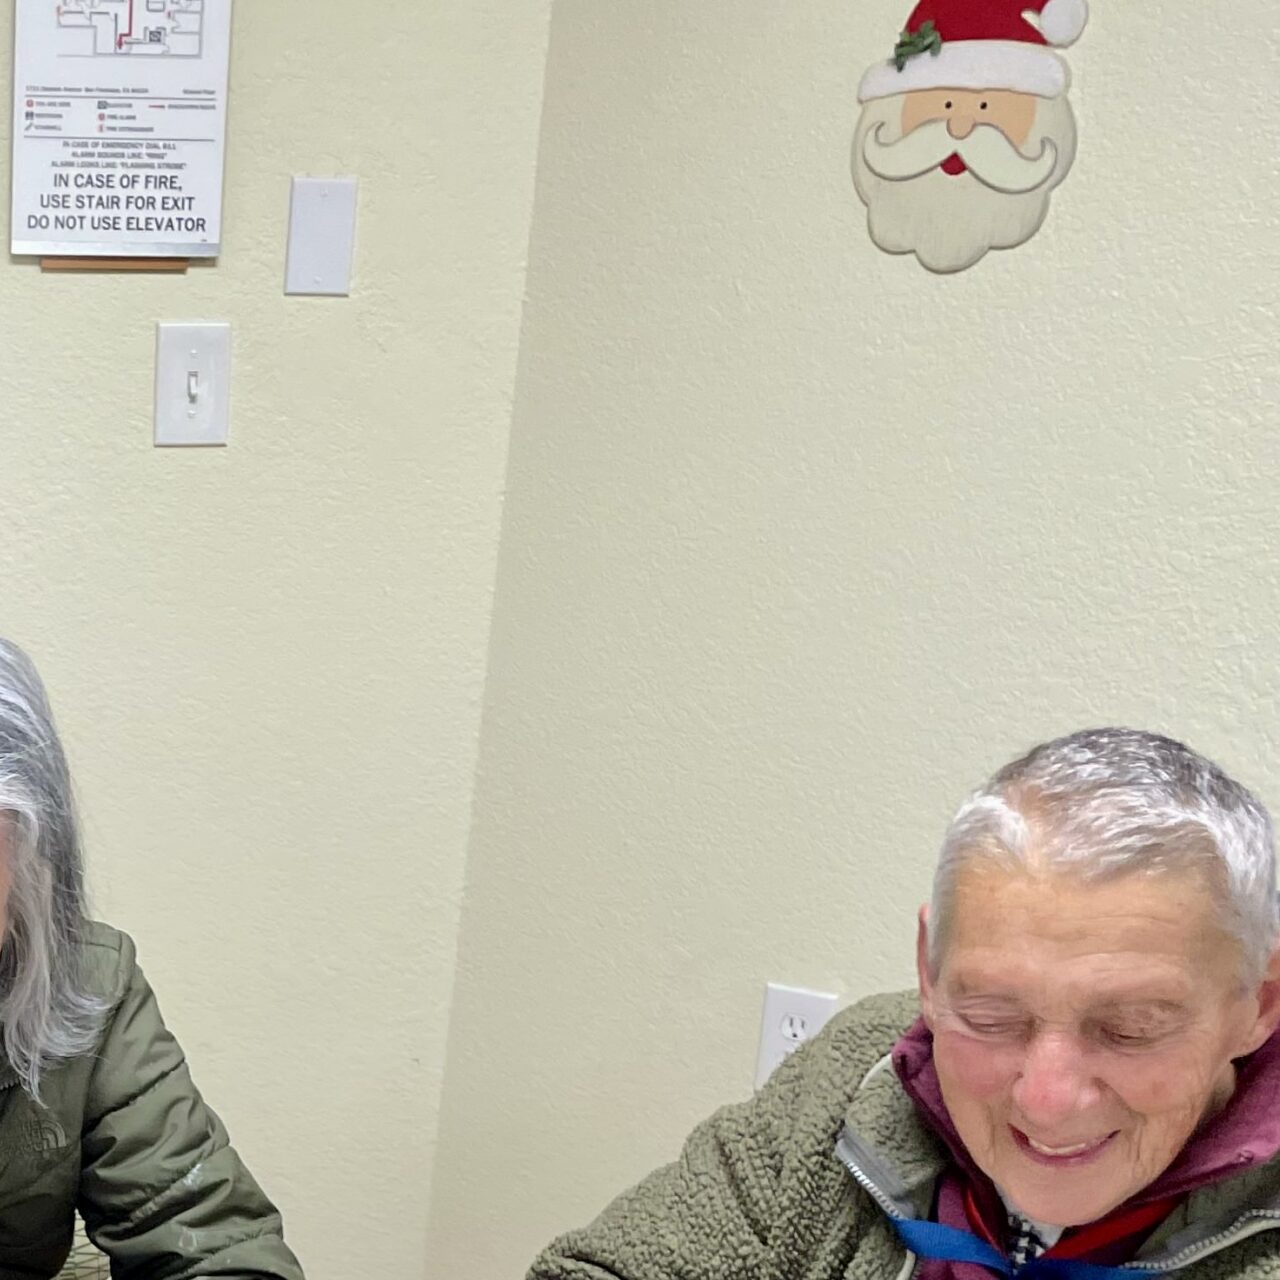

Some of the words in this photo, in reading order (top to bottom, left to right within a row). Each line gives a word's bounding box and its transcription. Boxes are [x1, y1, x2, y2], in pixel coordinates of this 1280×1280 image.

[54, 173, 69, 188] IN
[74, 174, 115, 189] CASE
[120, 175, 140, 189] OF
[144, 175, 182, 192] FIRE,
[40, 194, 70, 208] USE
[76, 194, 121, 209] STAIR
[126, 196, 156, 210] FOR
[161, 196, 194, 211] EXIT
[27, 215, 50, 229] DO
[54, 216, 86, 230] NOT
[91, 216, 122, 231] USE
[126, 217, 206, 232] ELEVATOR
